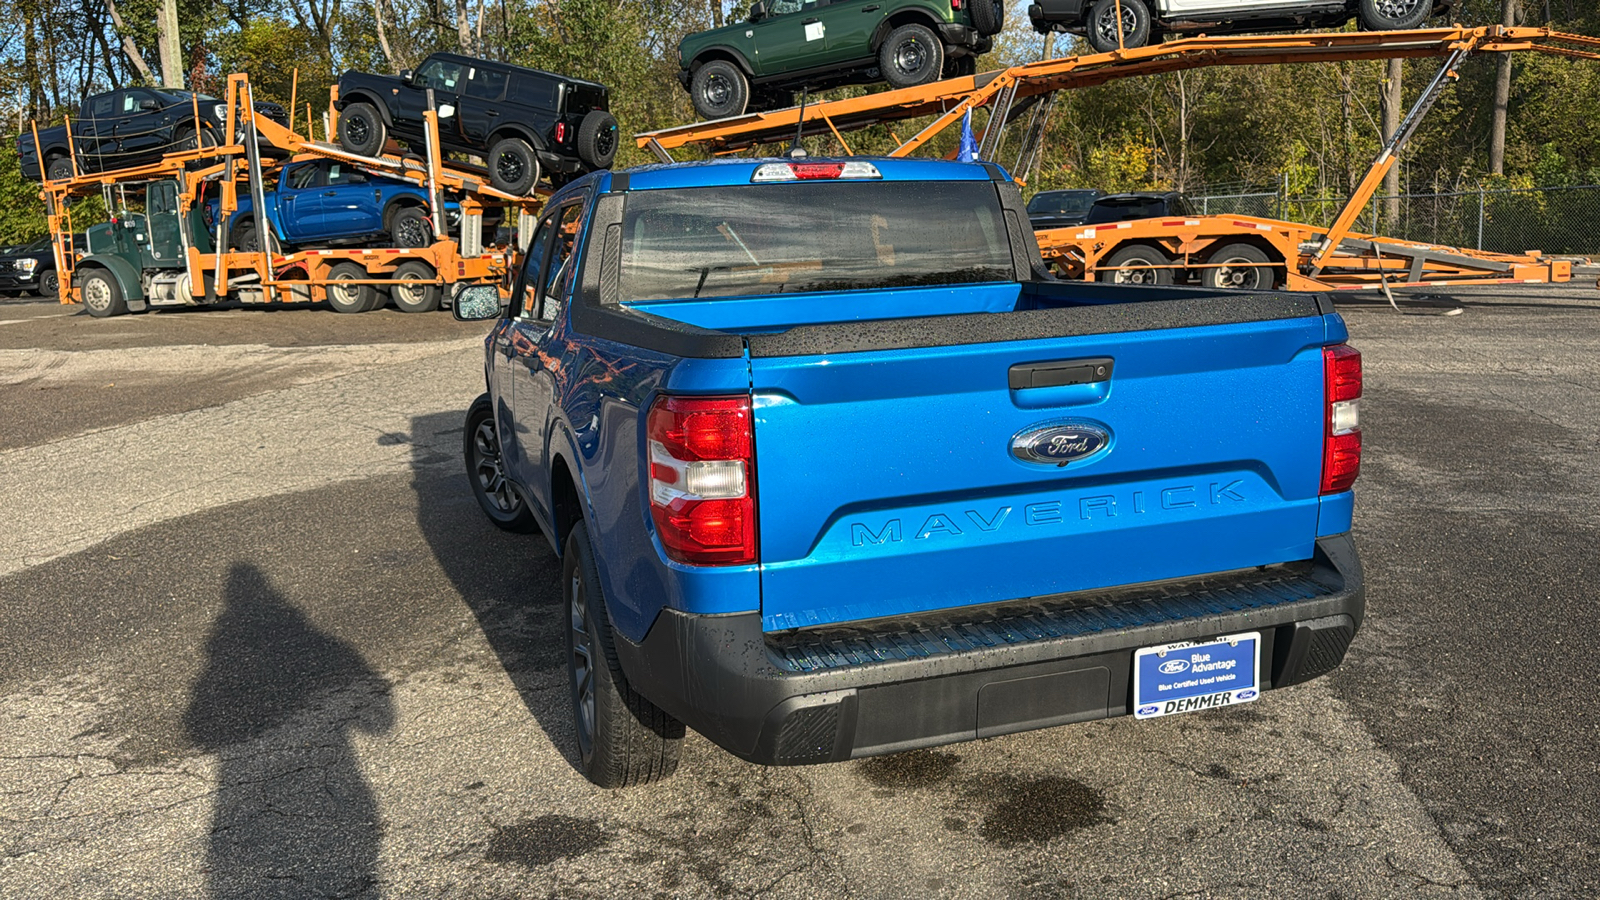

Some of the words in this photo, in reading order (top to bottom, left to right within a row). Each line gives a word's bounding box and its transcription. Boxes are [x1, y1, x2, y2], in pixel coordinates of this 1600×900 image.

[1047, 434, 1089, 456] Ford
[851, 479, 1248, 547] MAVERICK
[1191, 653, 1210, 663] Blue
[1191, 659, 1236, 673] Advantage
[1164, 661, 1185, 673] Ford
[1173, 679, 1198, 689] Certified
[1199, 677, 1214, 685] Used
[1215, 673, 1236, 683] Vehicle
[1164, 692, 1232, 714] DEMMER
